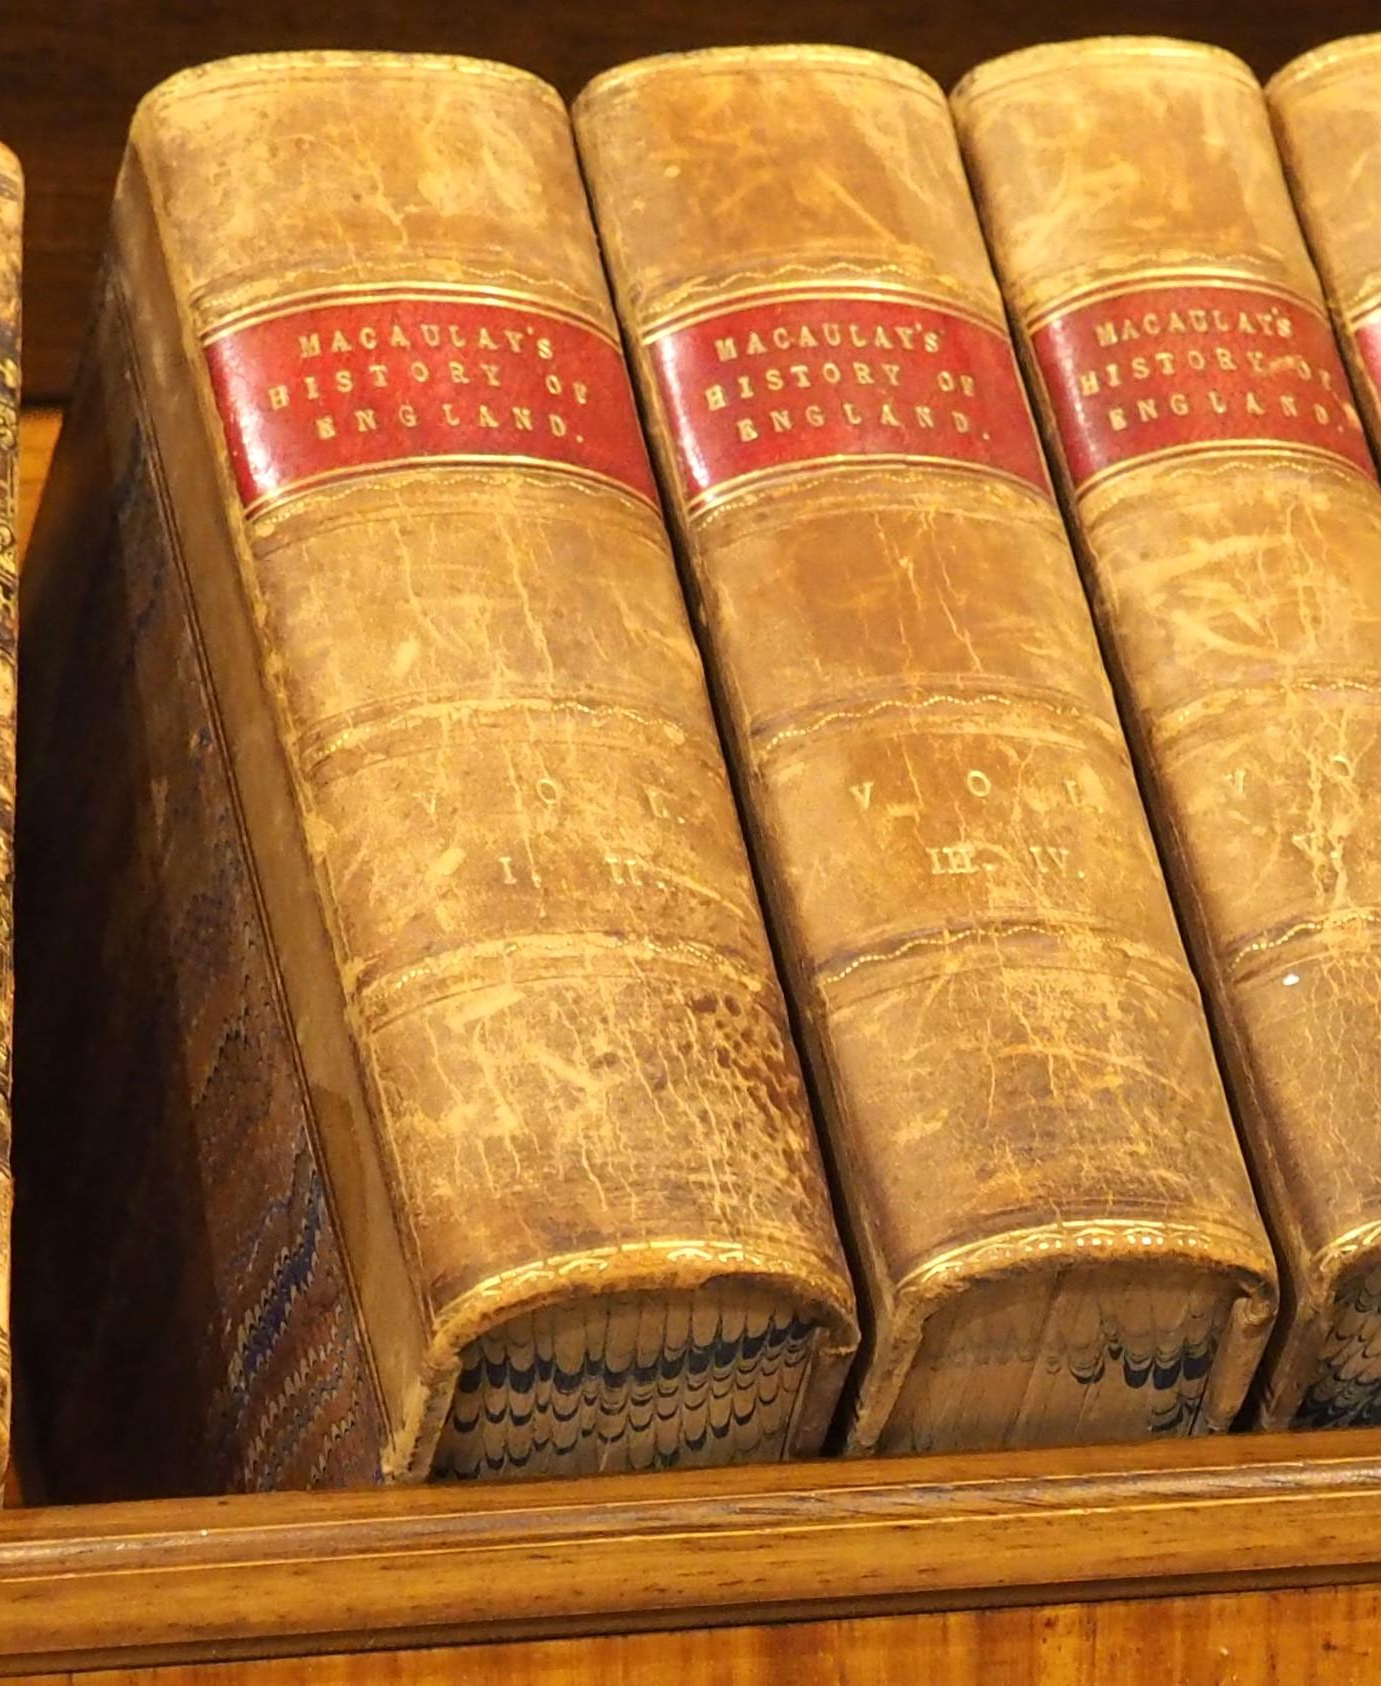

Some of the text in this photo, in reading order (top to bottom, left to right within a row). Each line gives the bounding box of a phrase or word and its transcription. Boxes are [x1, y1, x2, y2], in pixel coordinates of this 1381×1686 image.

[299, 324, 552, 360] MACAULAY'S
[715, 323, 939, 362] MACAULAY'S
[1095, 306, 1291, 347] MACAULAY'S
[269, 361, 588, 410] HISTORY OF
[705, 361, 975, 412] HISTORY OF
[1079, 347, 1264, 396] HISTORY
[316, 403, 584, 443] ENGLAND.
[737, 402, 991, 442] ENGLAND.
[1108, 390, 1345, 433] ENGLAND.
[1030, 845, 1085, 879] IV.
